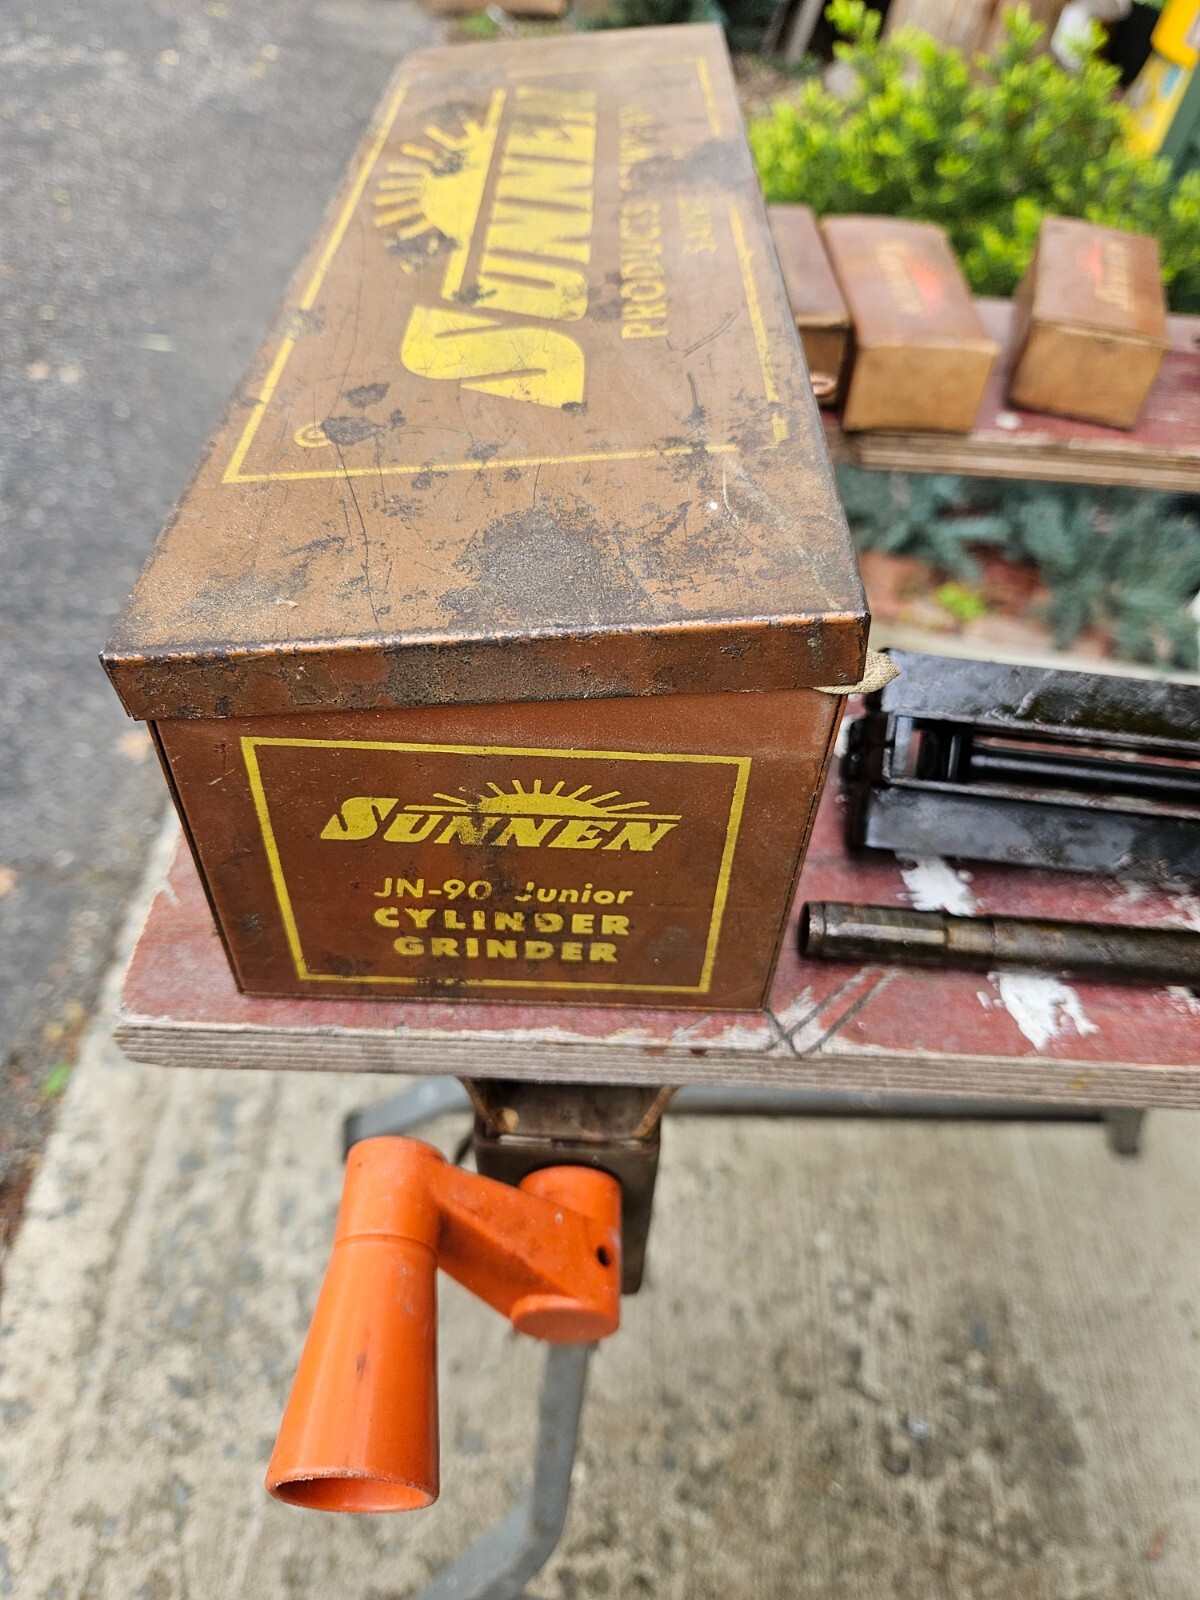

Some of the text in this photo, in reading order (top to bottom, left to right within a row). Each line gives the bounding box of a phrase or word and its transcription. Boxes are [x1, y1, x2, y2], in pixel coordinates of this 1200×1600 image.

[401, 86, 597, 408] SUNNEN
[320, 796, 679, 851] SUNNEN
[374, 877, 634, 905] JN-90 Junior
[373, 906, 631, 936] CYLINDER
[393, 936, 618, 964] GRINDER
